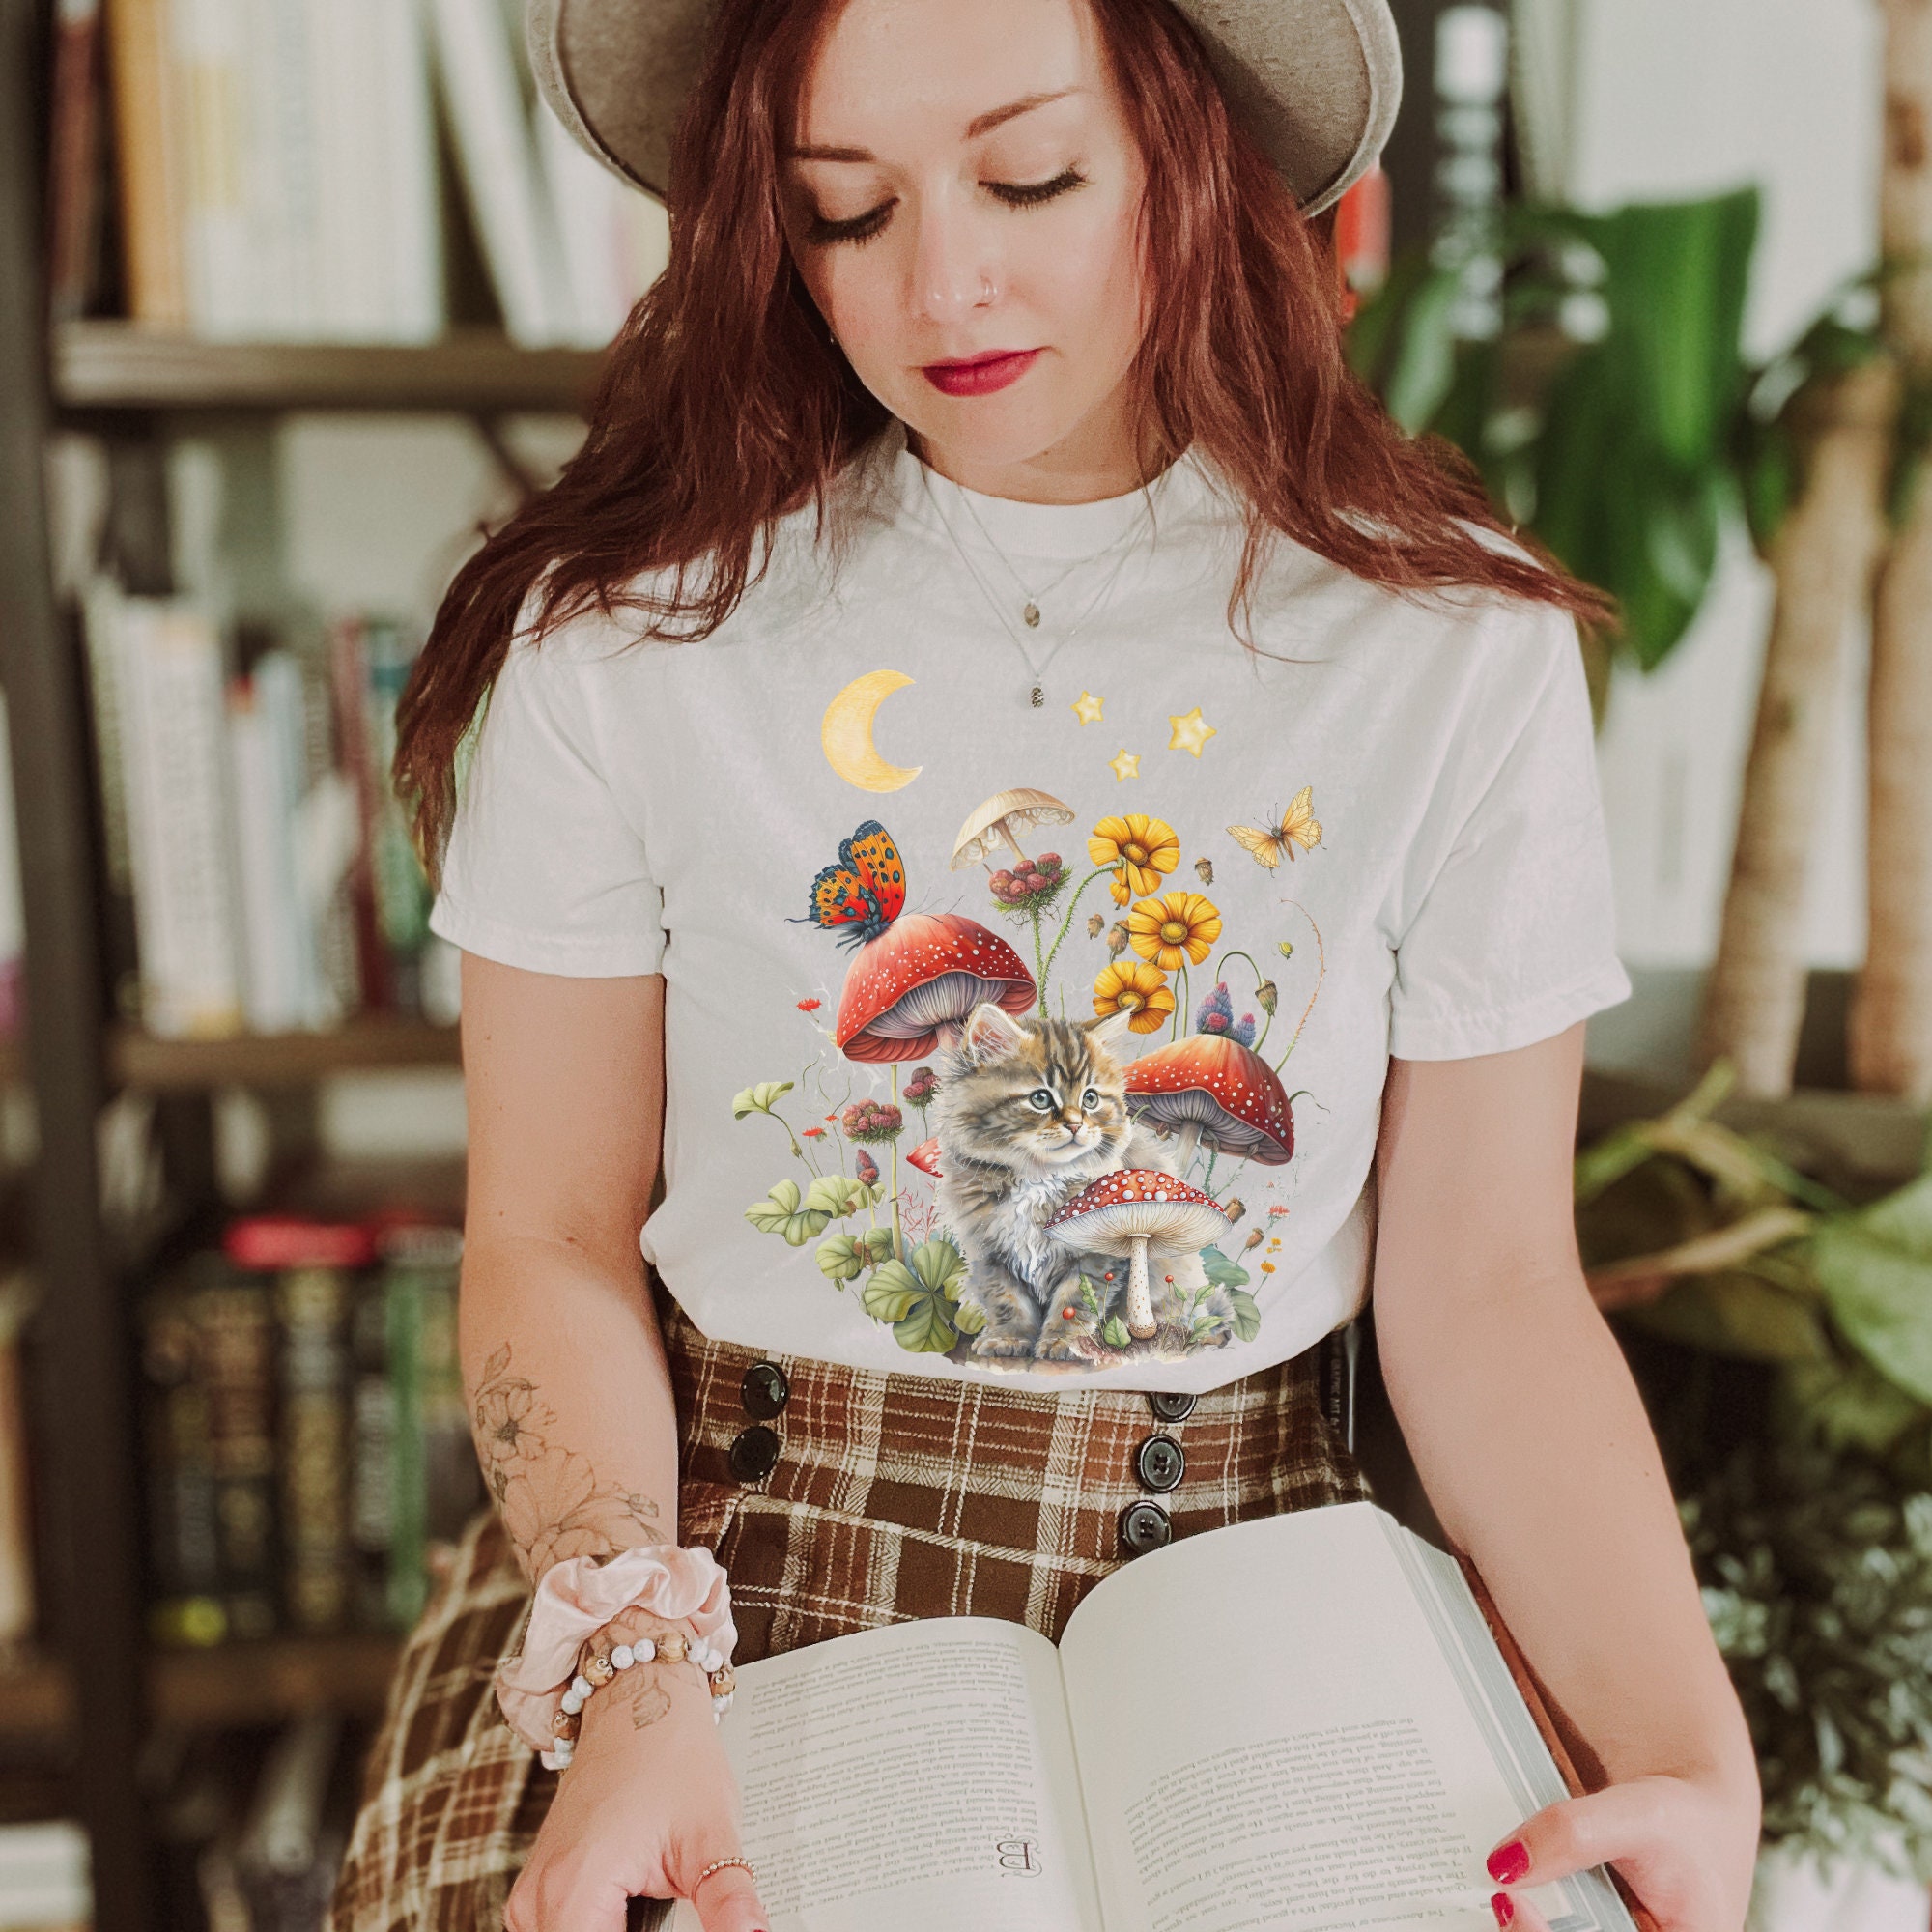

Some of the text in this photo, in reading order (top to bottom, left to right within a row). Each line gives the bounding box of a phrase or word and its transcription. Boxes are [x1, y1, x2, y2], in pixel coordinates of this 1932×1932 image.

[996, 1840, 1037, 1871] B
[1358, 1895, 1384, 1906] small
[1387, 1892, 1406, 1902] and
